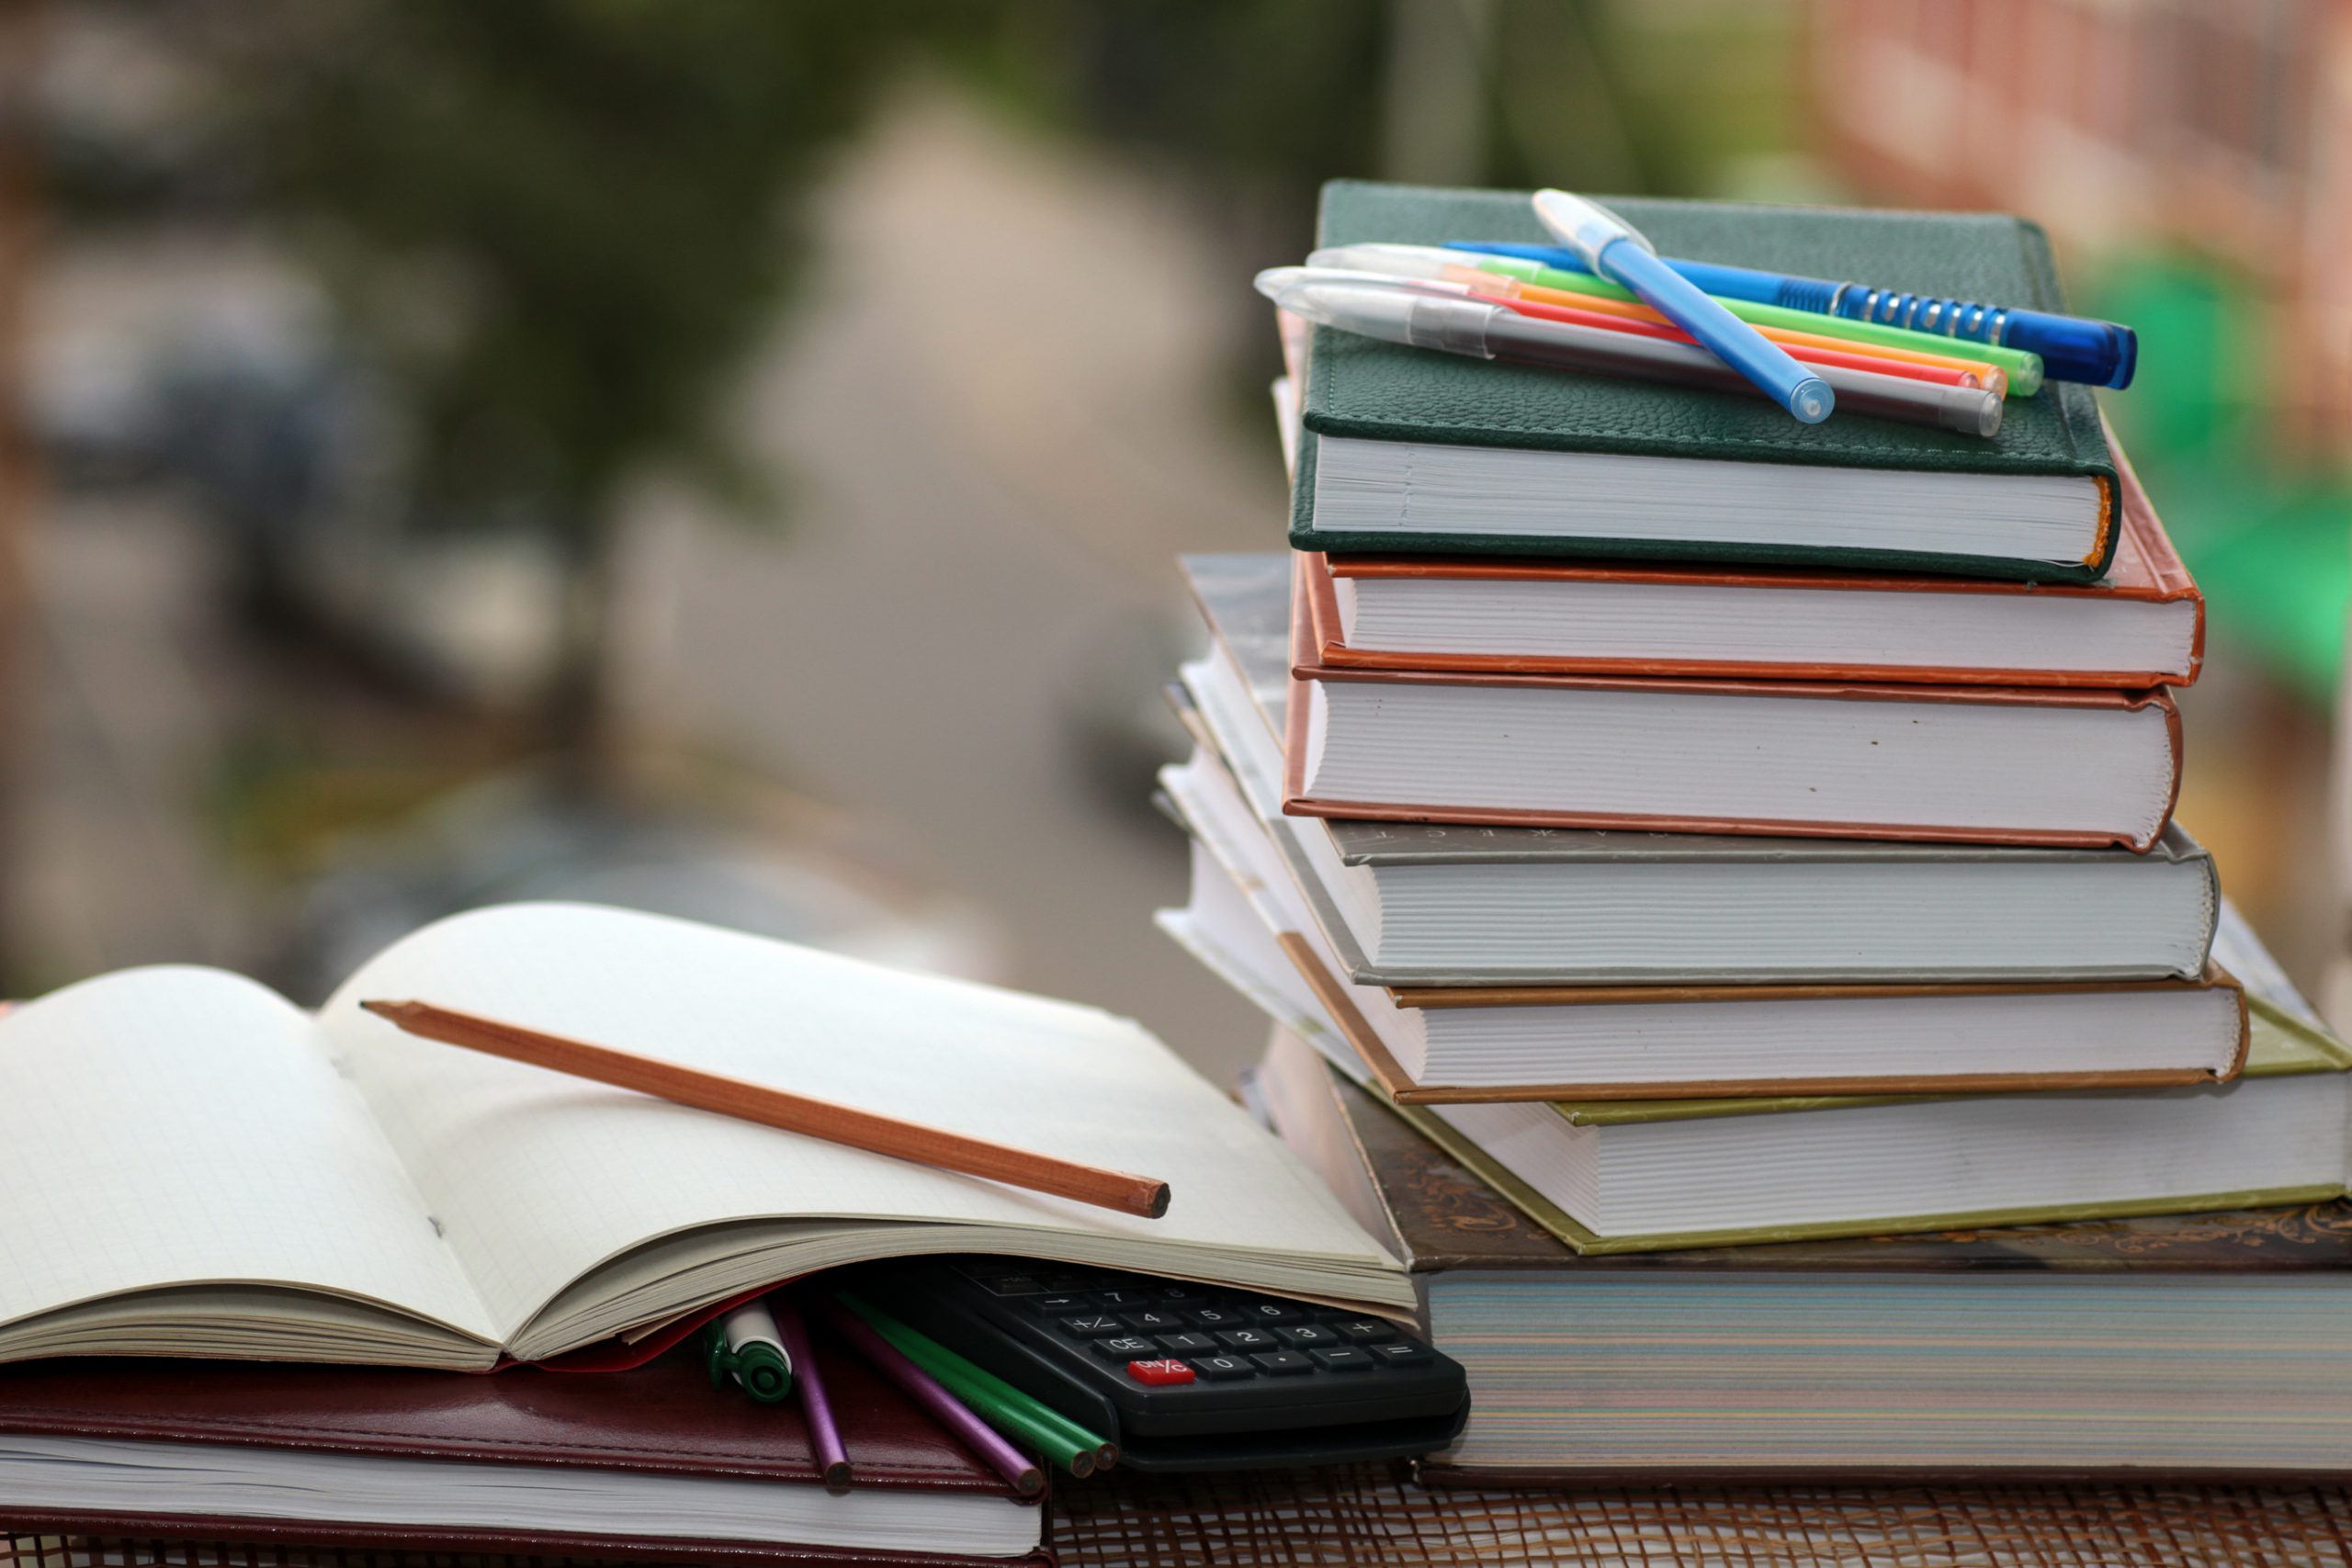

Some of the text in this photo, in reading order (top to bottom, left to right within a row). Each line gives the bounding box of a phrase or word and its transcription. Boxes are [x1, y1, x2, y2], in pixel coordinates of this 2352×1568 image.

[1103, 1292, 1122, 1302] 7
[1144, 1313, 1160, 1323] 4
[1199, 1310, 1222, 1320] 5
[1260, 1305, 1281, 1315] 6
[1109, 1337, 1144, 1350] CE
[1177, 1335, 1195, 1346] 1
[1237, 1331, 1260, 1342] 2
[1295, 1328, 1317, 1338] 3
[1136, 1359, 1188, 1374] ON/C
[1213, 1358, 1234, 1369] 0
